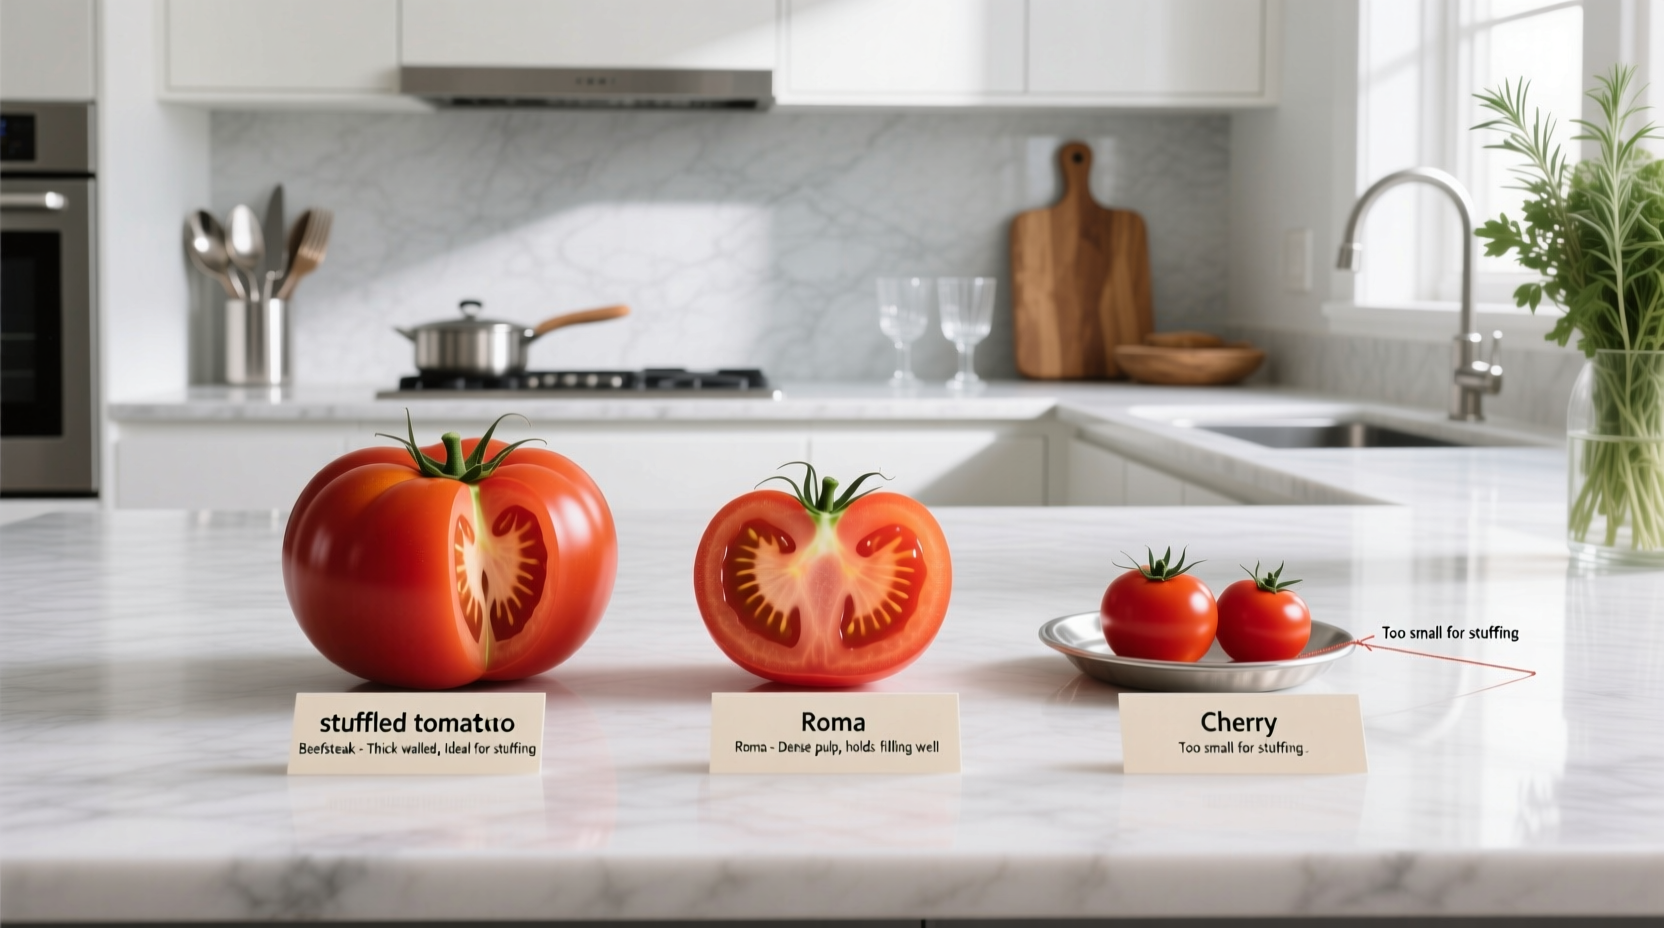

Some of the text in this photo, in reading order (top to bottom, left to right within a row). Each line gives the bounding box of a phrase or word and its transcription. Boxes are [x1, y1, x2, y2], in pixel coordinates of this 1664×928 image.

[320, 711, 407, 733] stuffled
[802, 712, 866, 732] Roma
[1201, 711, 1277, 738] Cherry
[366, 742, 398, 755] Thick
[401, 741, 441, 757] walled,
[444, 741, 471, 755] Ideal
[474, 742, 491, 755] for
[493, 742, 537, 757] stuffing
[735, 740, 768, 753] Roma
[814, 740, 842, 757] pulp,
[845, 740, 876, 753] holds
[880, 739, 913, 756] filling
[915, 740, 940, 753] well
[1178, 741, 1201, 754] Too
[1204, 741, 1234, 754] small
[1237, 741, 1255, 754] for
